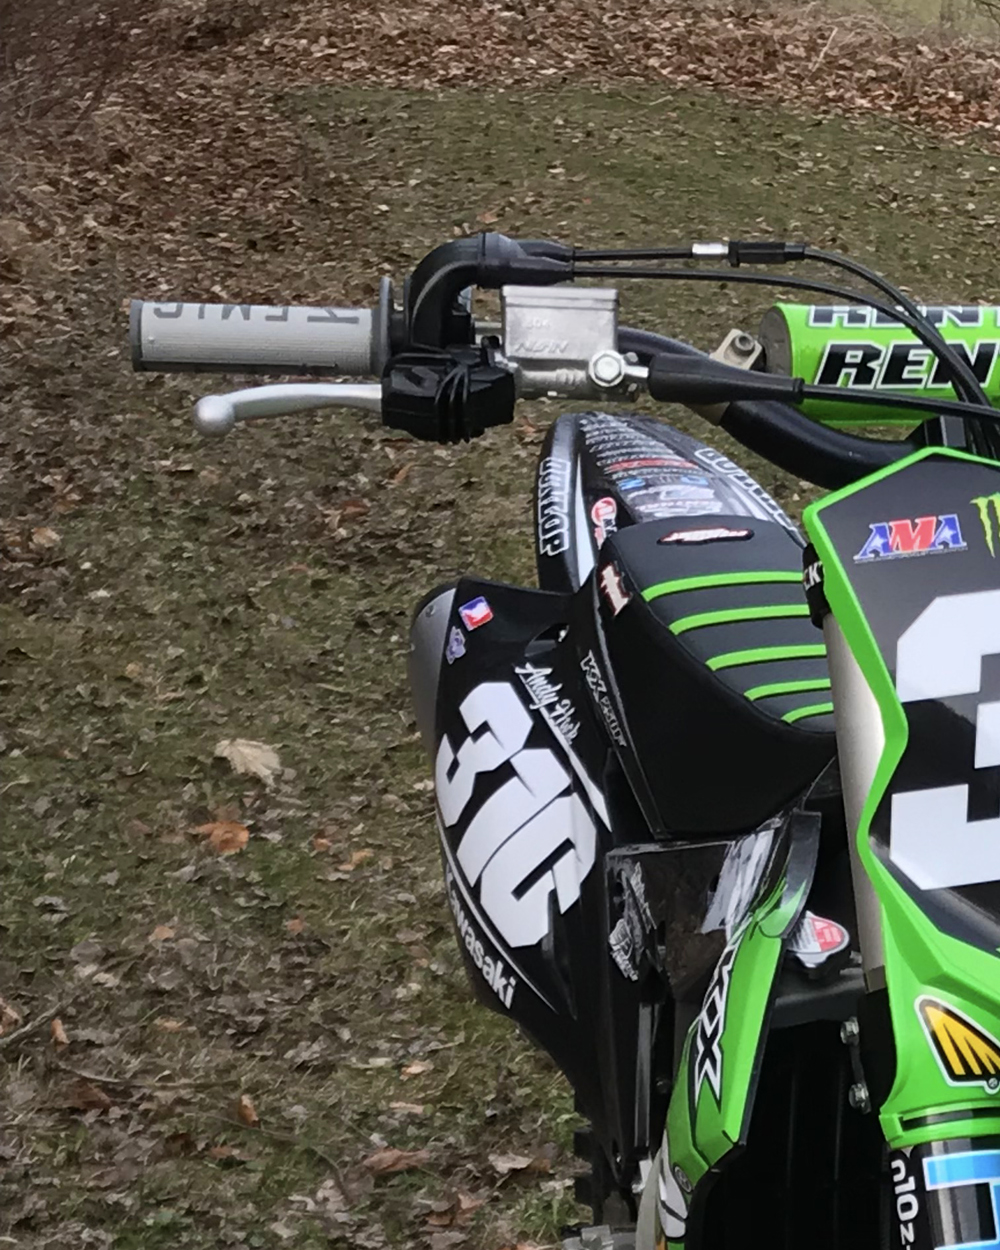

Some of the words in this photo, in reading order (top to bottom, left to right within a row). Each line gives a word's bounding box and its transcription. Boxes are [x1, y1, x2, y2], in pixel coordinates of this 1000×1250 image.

[853, 513, 968, 561] AMA
[514, 662, 558, 711] Andy
[435, 681, 597, 948] 310
